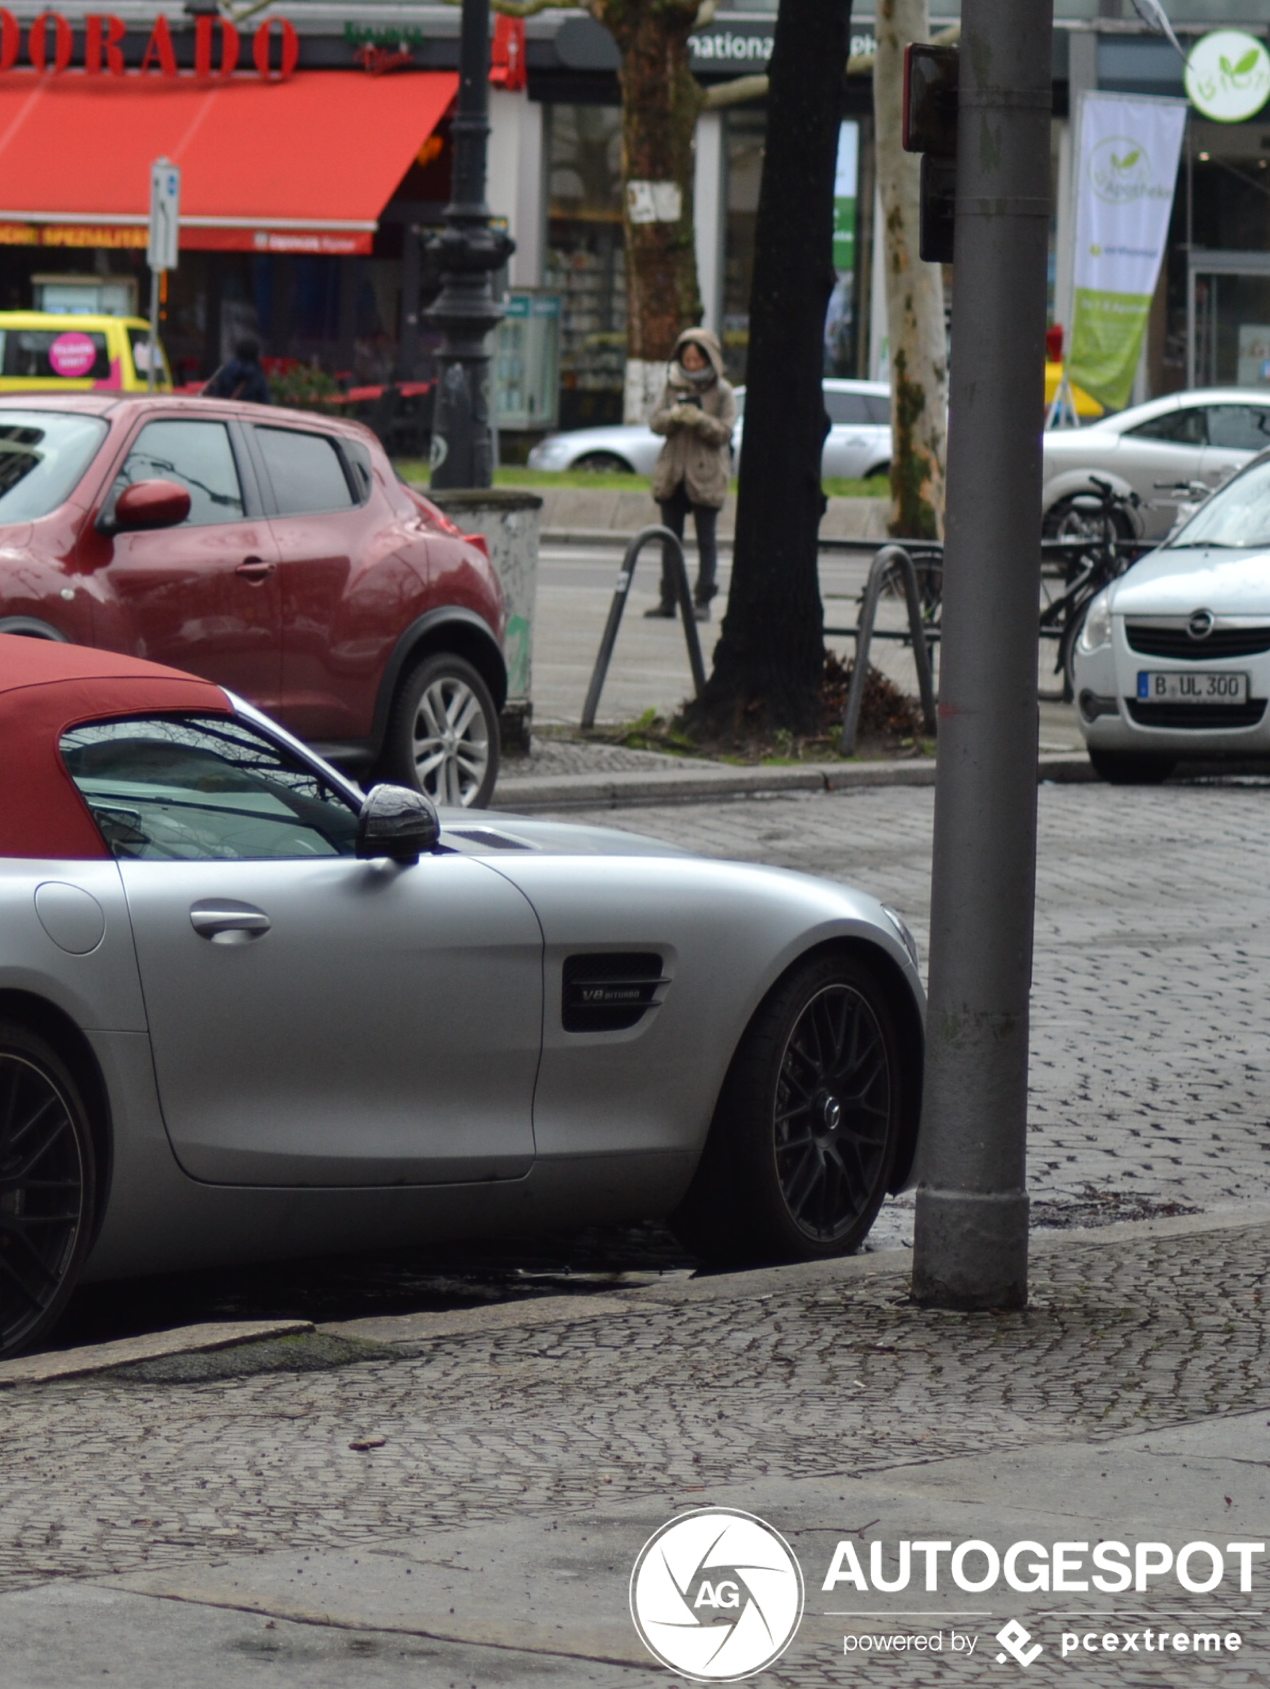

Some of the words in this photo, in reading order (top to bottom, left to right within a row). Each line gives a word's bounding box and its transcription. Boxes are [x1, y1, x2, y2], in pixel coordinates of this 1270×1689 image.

[1155, 677, 1166, 695] B
[1180, 677, 1202, 696] UL
[1206, 677, 1239, 697] 300
[582, 989, 604, 1001] V8
